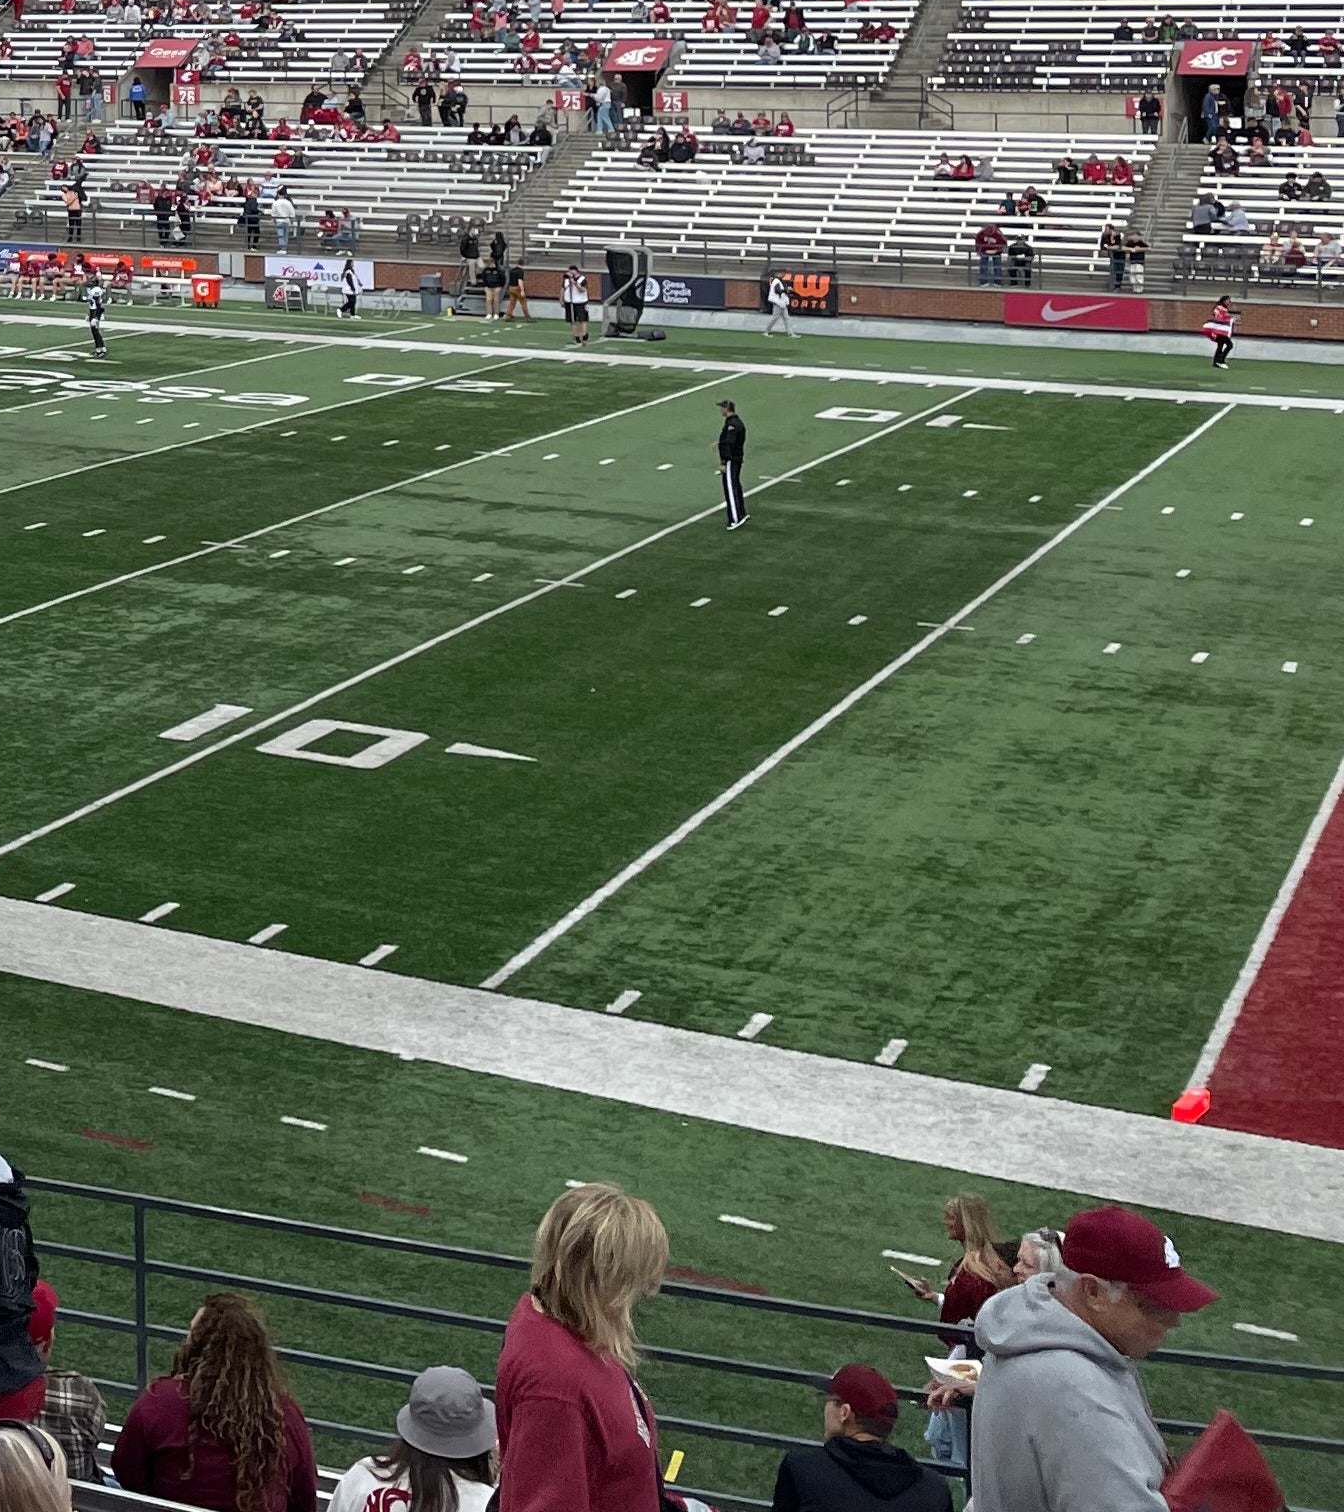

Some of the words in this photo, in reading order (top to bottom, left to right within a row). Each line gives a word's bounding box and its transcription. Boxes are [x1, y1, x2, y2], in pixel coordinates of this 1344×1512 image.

[150, 47, 187, 57] Gesa
[179, 90, 196, 105] 26
[562, 95, 581, 111] 25
[663, 96, 682, 112] 25
[282, 265, 319, 282] Coors
[197, 282, 210, 297] G
[662, 279, 686, 289] Gesa
[662, 287, 692, 297] Credit
[662, 295, 689, 304] Union
[158, 703, 431, 770] 10
